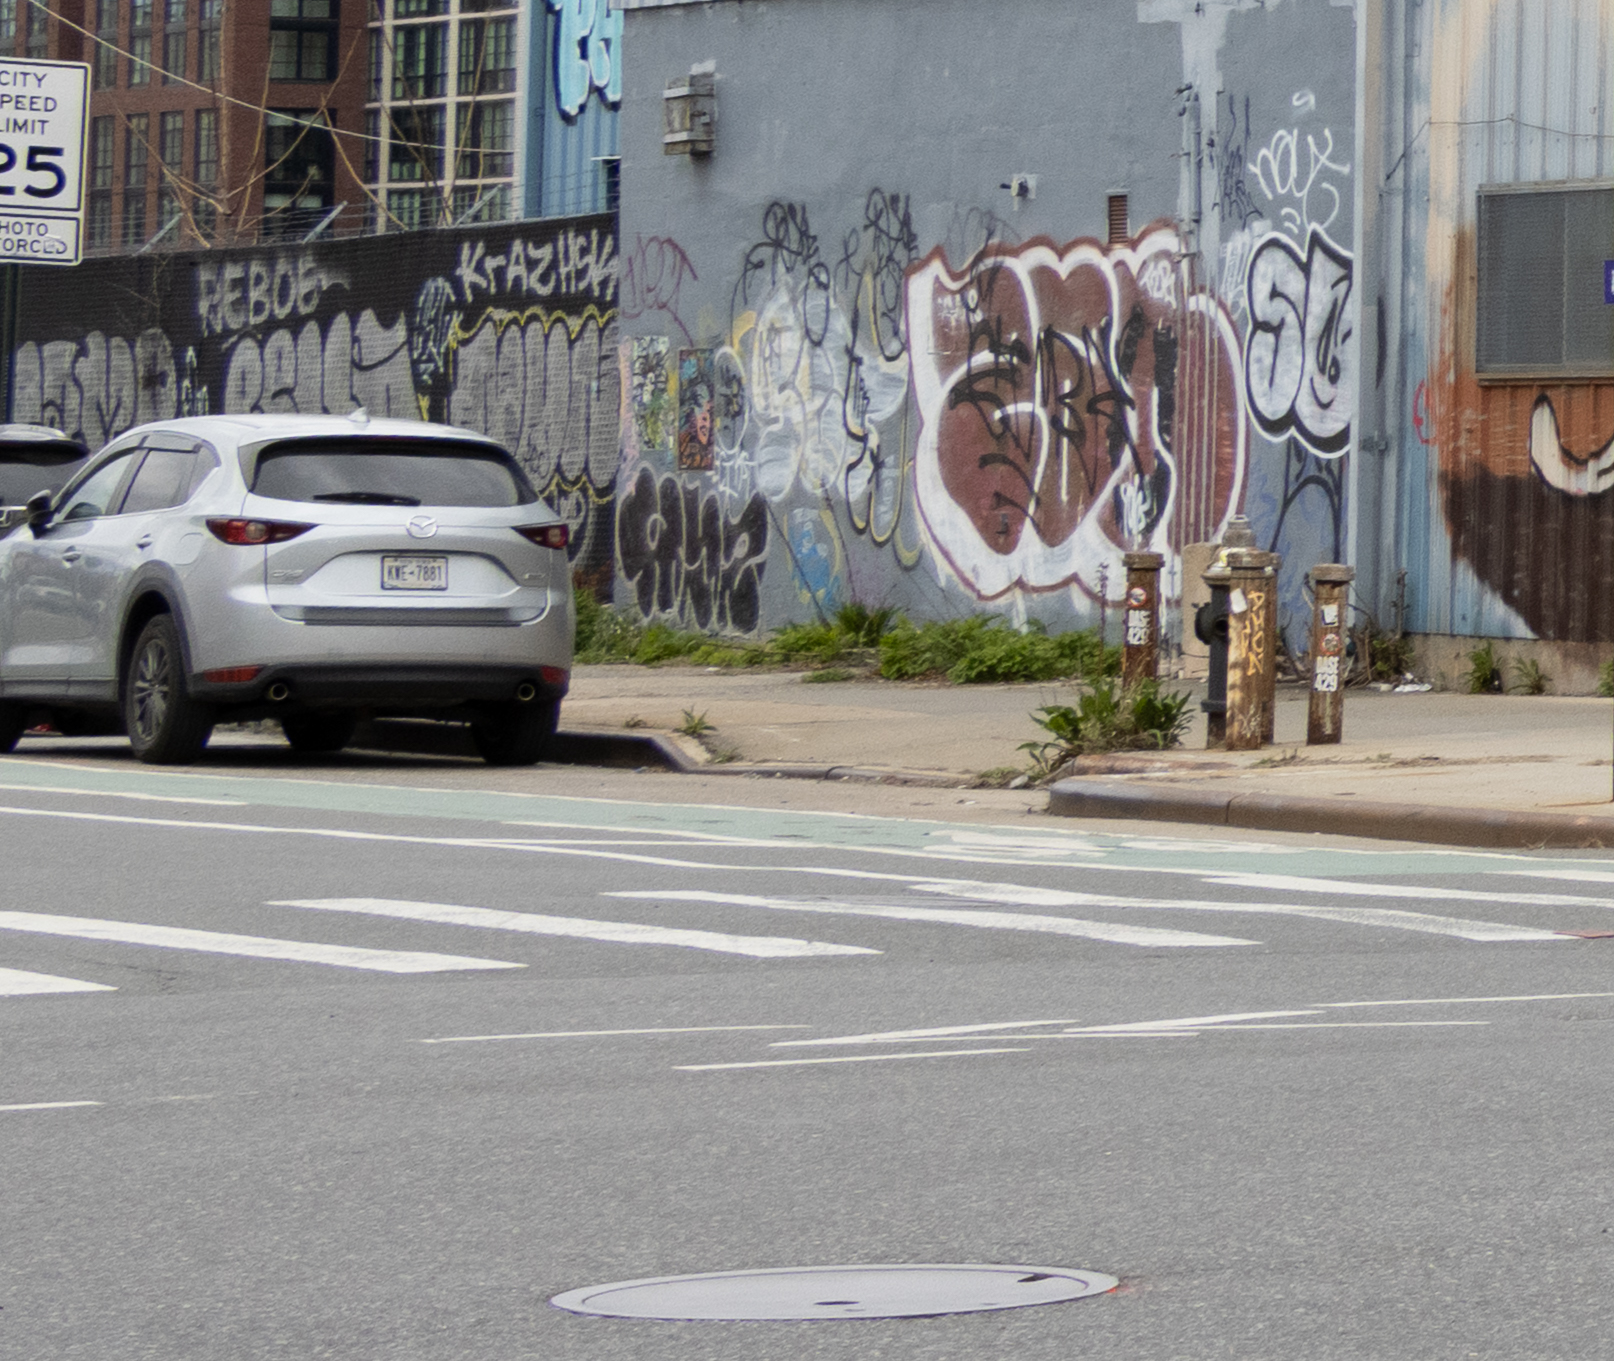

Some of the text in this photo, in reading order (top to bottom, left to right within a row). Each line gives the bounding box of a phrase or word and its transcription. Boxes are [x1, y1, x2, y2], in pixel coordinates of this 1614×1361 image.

[0, 70, 48, 89] CITY
[0, 93, 57, 113] PEED
[0, 117, 50, 136] IMIT
[0, 142, 67, 199] 25
[0, 220, 49, 237] HOTO
[0, 238, 68, 255] ORCED
